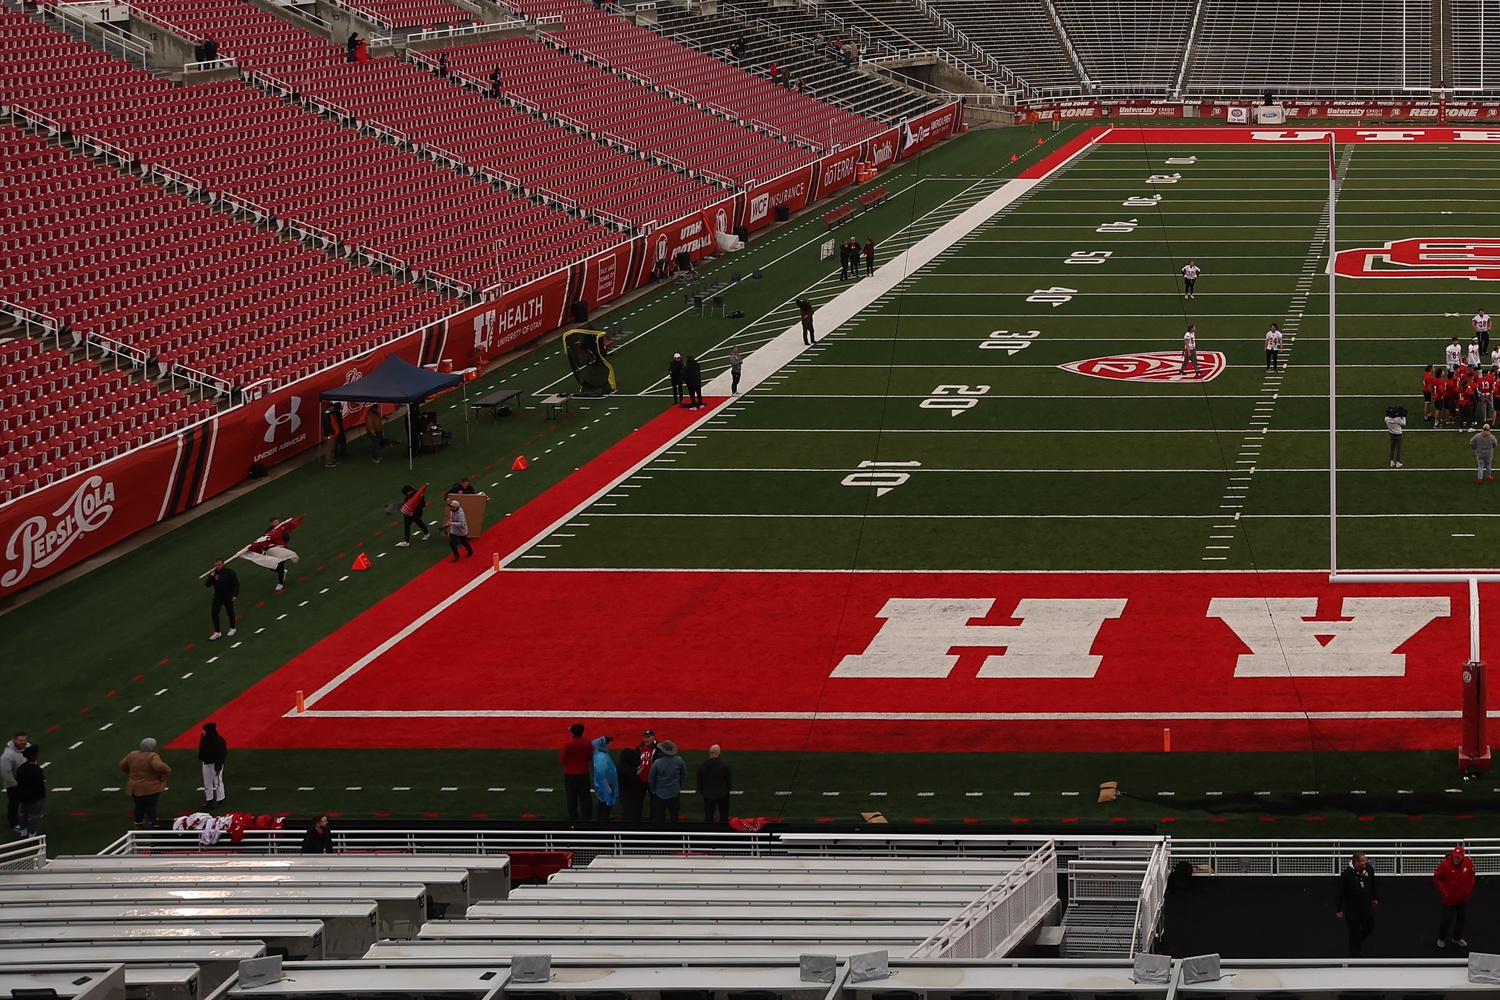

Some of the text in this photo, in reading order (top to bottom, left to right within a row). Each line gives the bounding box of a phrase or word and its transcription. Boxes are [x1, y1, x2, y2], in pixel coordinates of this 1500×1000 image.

[100, 8, 110, 20] 11
[1060, 108, 1095, 118] ZONE
[1119, 106, 1157, 115] University
[1327, 108, 1365, 117] University
[1409, 108, 1439, 117] RED
[872, 140, 892, 166] Smith's
[769, 183, 804, 208] INSURANCE
[680, 221, 702, 240] UTAH
[1064, 251, 1113, 264] 50
[1026, 287, 1078, 302] 40
[499, 295, 543, 334] HEALTH
[497, 320, 542, 348] UNIVERSITY OF UTAH
[978, 331, 1041, 349] 30
[1481, 381, 1489, 390] 13
[919, 385, 991, 408] 20
[254, 433, 306, 463] UNDER ARMOUR
[840, 461, 921, 486] 10
[1, 475, 116, 587] PEPSI-COLA
